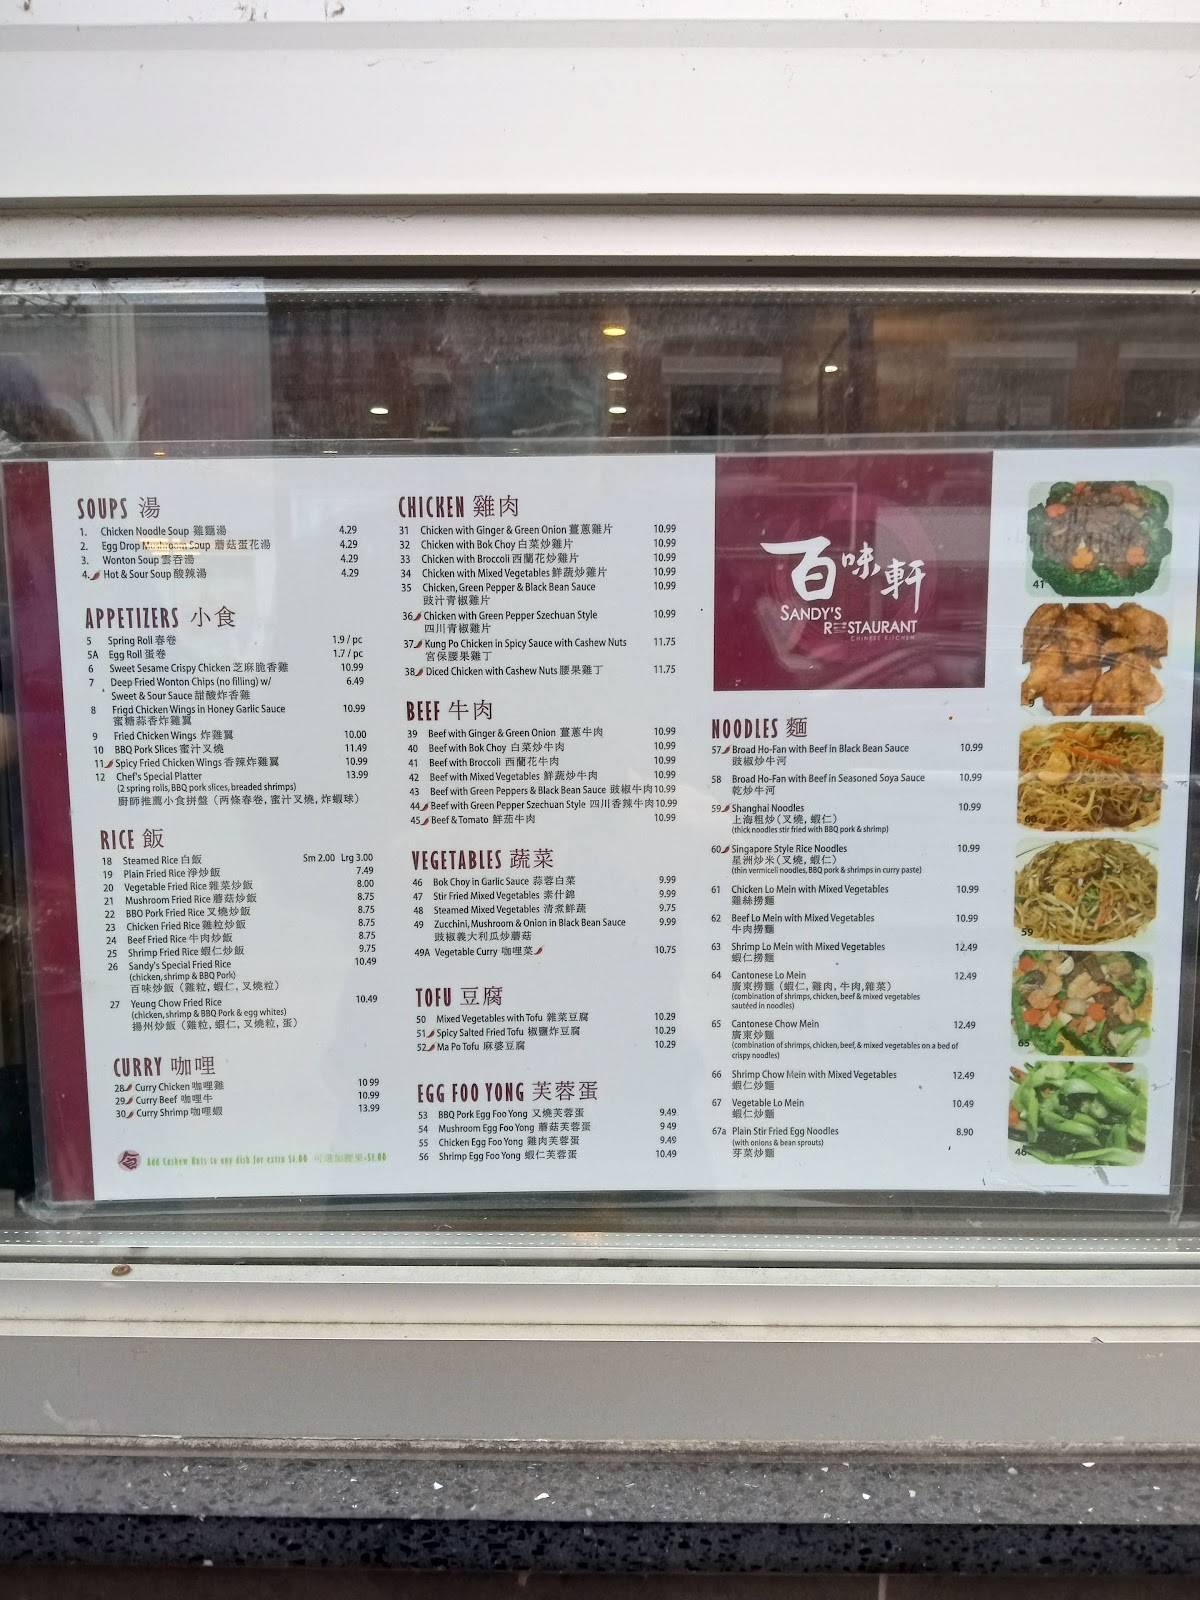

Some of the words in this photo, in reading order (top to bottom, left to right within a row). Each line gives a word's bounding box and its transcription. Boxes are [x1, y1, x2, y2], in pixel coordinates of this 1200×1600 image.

[77, 498, 128, 519] SOUPS
[398, 496, 465, 518] CHICKEN
[472, 495, 519, 517] 雞肉
[103, 569, 119, 579] Hot
[129, 569, 148, 579] Sour
[150, 569, 171, 581] Soup
[173, 567, 207, 580] 酸辣湯
[341, 568, 360, 578] 4.29
[760, 535, 927, 613] 百味軒
[1033, 579, 1044, 589] 41
[85, 608, 179, 629] APPETIZERS
[190, 606, 236, 627] 小食
[402, 611, 414, 621] 36
[423, 610, 456, 621] Chicken
[458, 610, 476, 621] with
[478, 610, 503, 621] Green
[505, 610, 534, 622] Pepper
[536, 610, 573, 620] Szechuan
[575, 609, 598, 622] Style
[653, 609, 677, 619] 10.99
[780, 603, 841, 621] SANDY'S
[424, 622, 492, 634] 四川青椒雞片
[107, 635, 135, 648] Spring
[137, 635, 152, 645] Roll
[154, 634, 177, 646] 春卷
[332, 634, 344, 644] 1.9
[352, 636, 363, 646] pc
[109, 663, 135, 673] Sweet
[137, 663, 169, 673] Sesame
[171, 663, 196, 675] Crispy
[198, 662, 230, 673] Chicken
[340, 662, 364, 672] 10.99
[406, 701, 440, 721] BEEF
[448, 700, 493, 720] 牛肉
[711, 718, 779, 739] NOODLES
[407, 744, 419, 753] 40
[428, 743, 447, 753] Beef
[449, 743, 466, 753] with
[468, 743, 484, 753] Bok
[486, 742, 507, 754] Choy
[511, 741, 565, 753] 白菜炒牛肉
[654, 741, 677, 750] 10.99
[95, 772, 106, 782] 12
[116, 771, 141, 782] Chef's
[143, 771, 172, 783] Special
[174, 771, 203, 781] Platter
[346, 770, 369, 780] 13.99
[711, 775, 722, 784] 58
[732, 774, 755, 784] Broad
[757, 774, 786, 784] Ho-Fan
[788, 773, 806, 783] with
[808, 773, 827, 783] Beef
[838, 772, 877, 783] Seasoned
[879, 773, 898, 785] Soya
[900, 773, 926, 783] Sauce
[959, 772, 983, 782] 10.99
[126, 783, 150, 795] spring
[172, 783, 187, 792] BBQ
[189, 782, 206, 794] pork
[208, 782, 230, 793] slices,
[231, 782, 263, 791] breaded
[265, 781, 297, 793] shrimps)
[731, 784, 776, 797] 乾炒牛河
[711, 804, 722, 813] 59
[731, 803, 769, 815] Shanghai
[771, 802, 805, 813] Noodles
[958, 802, 982, 812] 10.99
[99, 830, 135, 850] RICE
[101, 856, 113, 866] 18
[122, 855, 159, 866] Steamed
[161, 855, 178, 865] Rice
[180, 854, 202, 865] 白飯
[302, 853, 315, 863] Sm
[317, 853, 336, 863] 2.00
[340, 853, 353, 864] Lrg
[355, 853, 374, 862] 3.00
[411, 850, 502, 870] VEGETABLES
[509, 849, 554, 868] 蔬菜
[413, 906, 424, 915] 48
[433, 905, 467, 915] Steamed
[469, 904, 494, 914] Mixed
[496, 904, 540, 916] Vegetables
[658, 903, 677, 912] 9.75
[106, 936, 117, 945] 24
[127, 935, 146, 945] Beef
[148, 934, 167, 944] Fried
[169, 934, 186, 944] Rice
[188, 932, 233, 944] 牛肉炒飯
[358, 930, 376, 940] 8.75
[1021, 928, 1033, 936] 59
[107, 962, 119, 972] 26
[128, 960, 159, 973] Sandy's
[161, 960, 190, 972] Special
[192, 959, 212, 969] Fried
[214, 959, 232, 969] Rice
[354, 956, 377, 966] 10.49
[415, 988, 452, 1007] TOFU
[460, 986, 503, 1005] 豆腐
[416, 1015, 427, 1024] 50
[436, 1014, 460, 1024] Mixed
[462, 1013, 505, 1025] Vegetables
[507, 1013, 524, 1022] with
[526, 1012, 543, 1022] Tofu
[654, 1012, 676, 1021] 10.29
[711, 1019, 722, 1028] 65
[731, 1019, 773, 1029] Cantonese
[775, 1019, 797, 1029] Chow
[799, 1019, 820, 1029] Mein
[953, 1020, 976, 1030] 12.49
[1018, 1039, 1030, 1047] 65
[113, 1057, 162, 1077] CURRY
[170, 1056, 217, 1075] 咖哩
[114, 1096, 126, 1106] 29
[135, 1096, 157, 1106] Curry
[159, 1094, 178, 1104] Beef
[180, 1093, 214, 1104] 咖哩牛
[357, 1090, 380, 1100] 10.99
[417, 1084, 445, 1103] EGG
[451, 1083, 479, 1102] FOO
[484, 1082, 524, 1102] YONG
[531, 1081, 598, 1101] 芙蓉蛋
[711, 1126, 727, 1136] 67a
[732, 1126, 751, 1136] Plain
[753, 1126, 766, 1136] Stir
[768, 1126, 788, 1136] Fried
[790, 1126, 804, 1138] Egg
[806, 1126, 839, 1136] Noodles
[956, 1127, 974, 1137] 8.90
[418, 1138, 429, 1148] 55
[438, 1137, 469, 1147] Chicken
[471, 1137, 486, 1149] Egg
[488, 1137, 502, 1146] Foo
[504, 1137, 524, 1148] Yong
[659, 1135, 677, 1145] 9.49
[732, 1138, 749, 1147] (with
[751, 1138, 772, 1147] onions
[780, 1138, 796, 1147] bean
[798, 1138, 825, 1148] sprouts)
